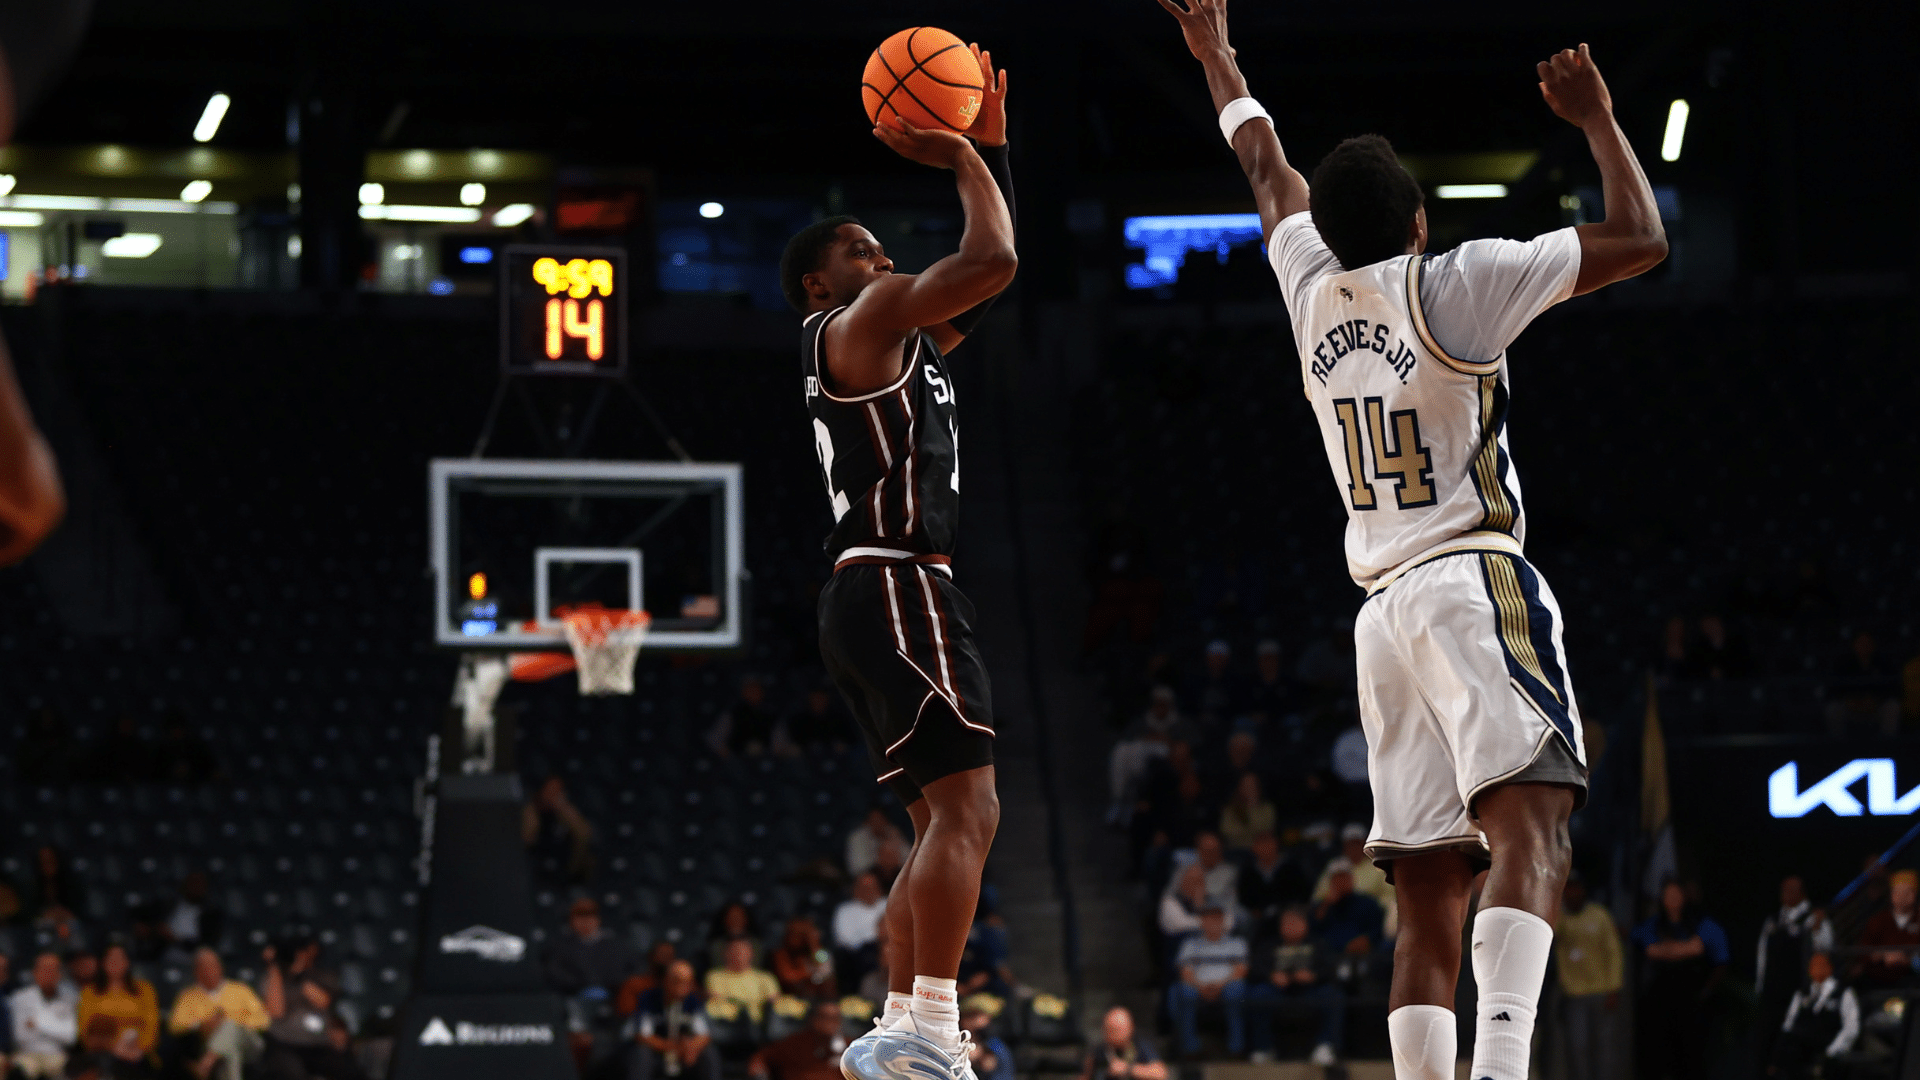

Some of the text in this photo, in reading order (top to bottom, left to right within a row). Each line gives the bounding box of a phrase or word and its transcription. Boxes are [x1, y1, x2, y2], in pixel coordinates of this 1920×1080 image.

[532, 257, 613, 299] 9:59
[545, 298, 604, 360] 14
[1311, 319, 1417, 388] REEVES JR.
[1332, 396, 1438, 511] 14
